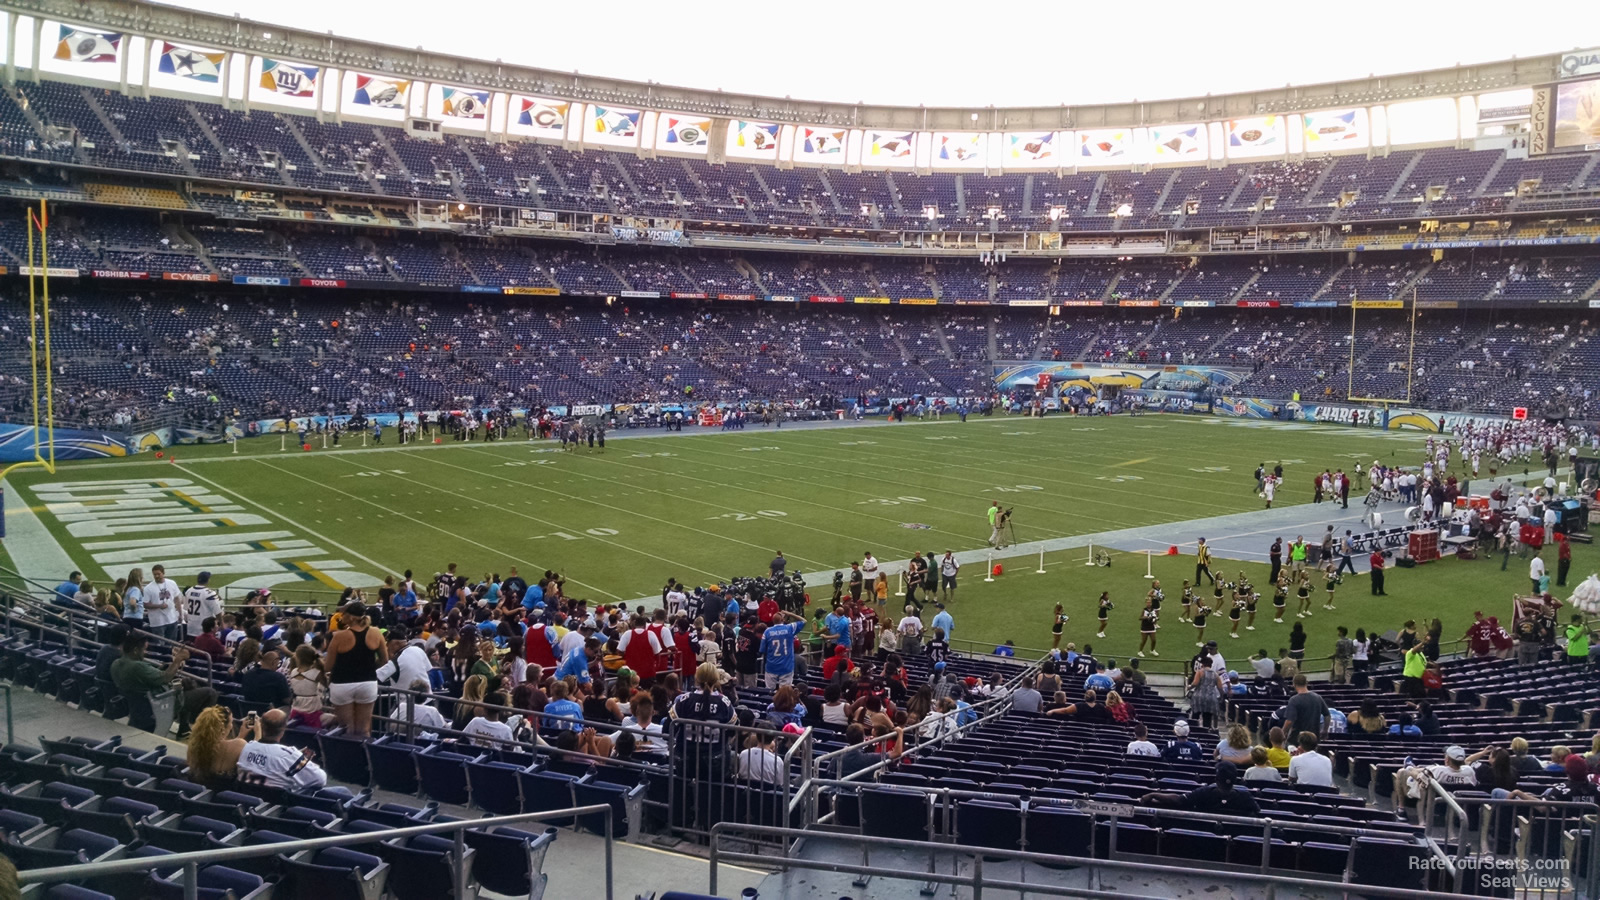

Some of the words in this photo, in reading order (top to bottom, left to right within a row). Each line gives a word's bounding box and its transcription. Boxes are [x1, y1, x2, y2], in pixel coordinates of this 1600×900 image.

[277, 70, 302, 90] ny
[1533, 91, 1545, 153] SYCUAN
[170, 273, 211, 281] CYMER
[246, 277, 281, 285] GEICO
[310, 279, 338, 287] TOYOTA
[722, 509, 788, 521] 20
[547, 527, 620, 541] 10
[188, 599, 201, 616] 32
[772, 639, 788, 657] 21
[555, 704, 573, 712] RIVERS
[694, 702, 718, 713] GES
[247, 751, 268, 766] RIVERS
[1446, 775, 1465, 784] GATES
